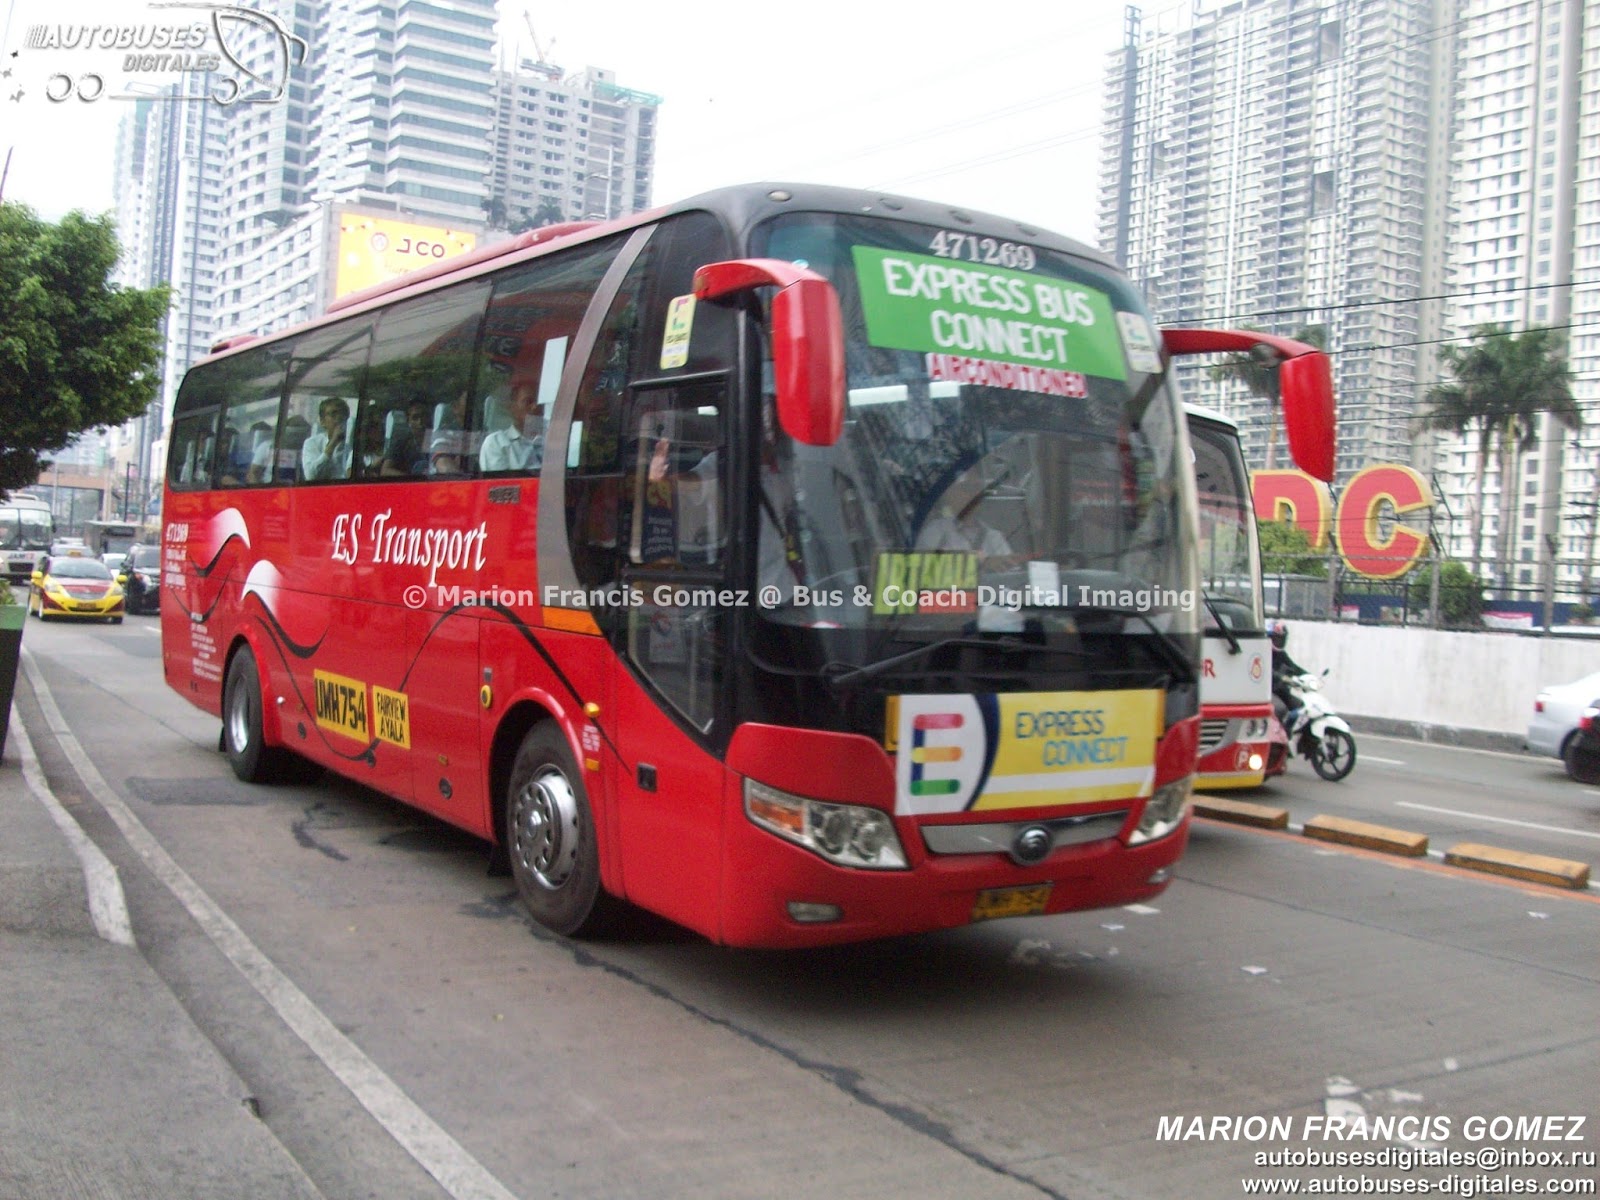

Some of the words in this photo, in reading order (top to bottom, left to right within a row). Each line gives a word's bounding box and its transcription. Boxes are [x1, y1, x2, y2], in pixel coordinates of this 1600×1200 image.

[929, 230, 1036, 271] 471269
[882, 257, 1032, 315] EXPRESS
[1033, 283, 1096, 327] BUS
[930, 310, 1069, 364] CONNECT
[331, 513, 362, 566] ES
[371, 507, 488, 588] Transport
[315, 678, 366, 733] UMH754
[376, 692, 406, 722] FAIRVIEW
[1015, 710, 1105, 739] EXPRESS
[380, 716, 405, 743] AYALA
[1042, 736, 1128, 766] CONNECT
